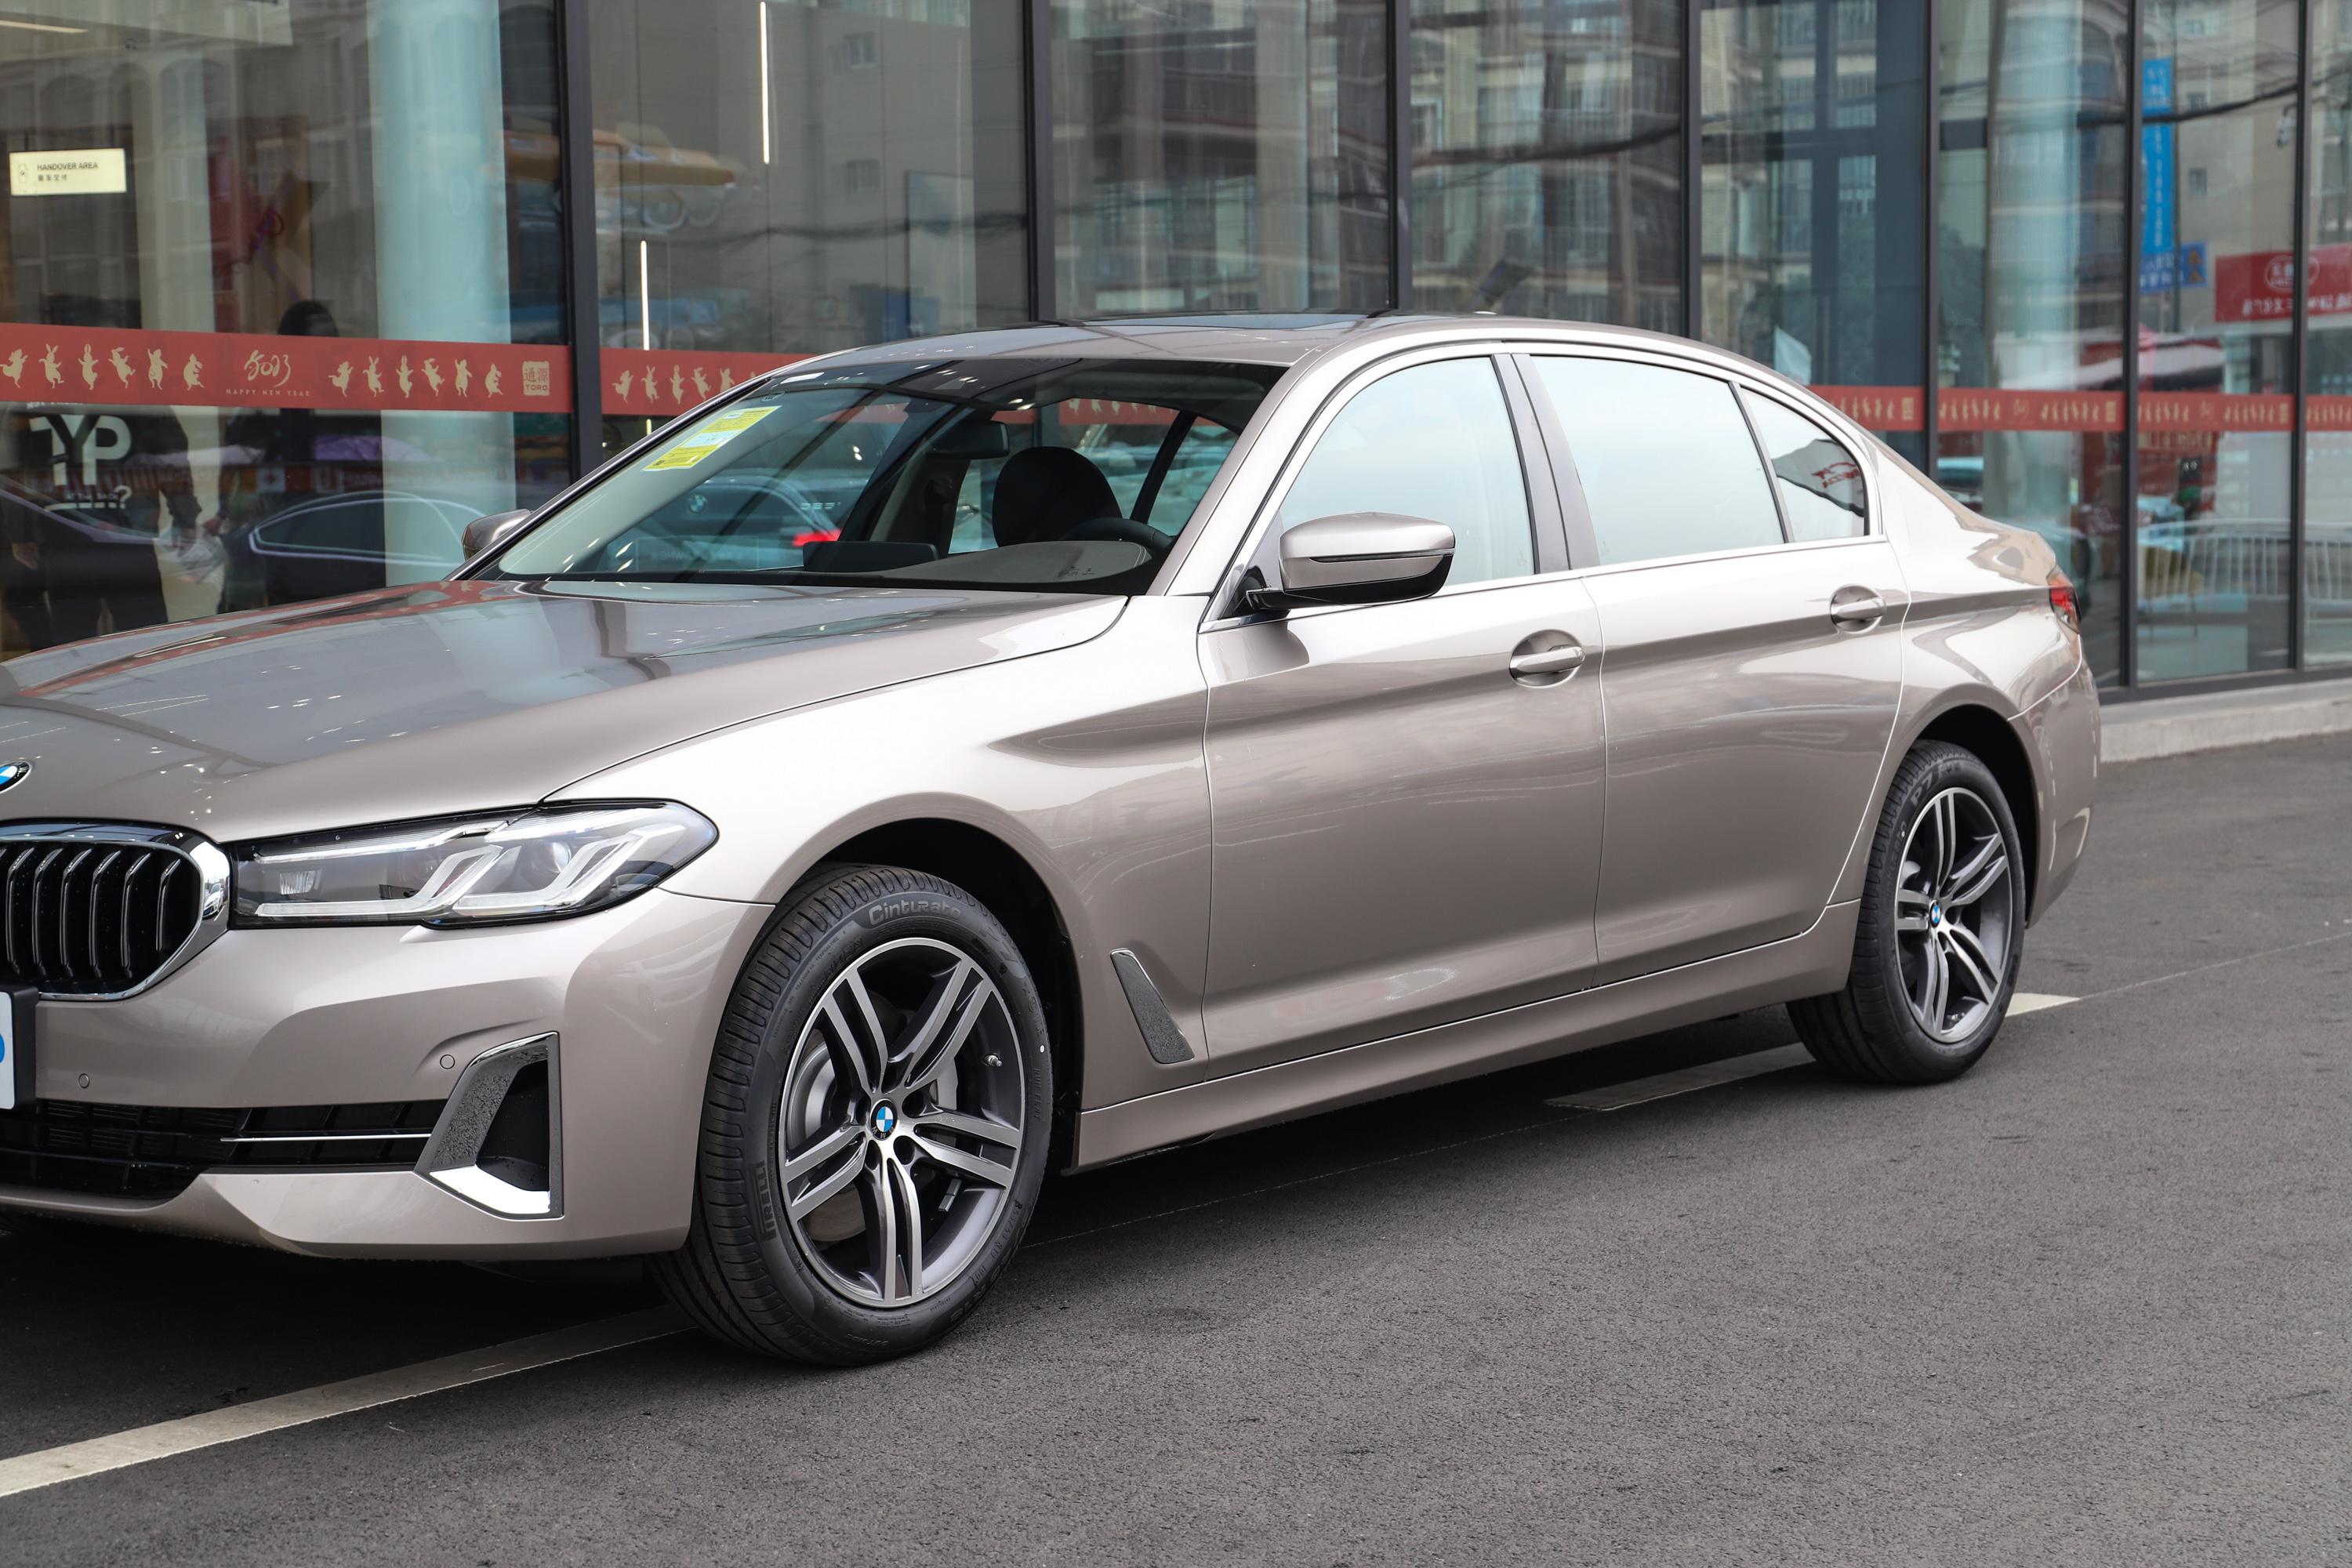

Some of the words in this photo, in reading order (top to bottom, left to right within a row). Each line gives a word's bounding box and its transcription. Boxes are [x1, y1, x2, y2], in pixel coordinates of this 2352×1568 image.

[38, 162, 77, 171] HANDOVER
[1910, 771, 1934, 808] P7
[868, 899, 962, 926] Cinturato
